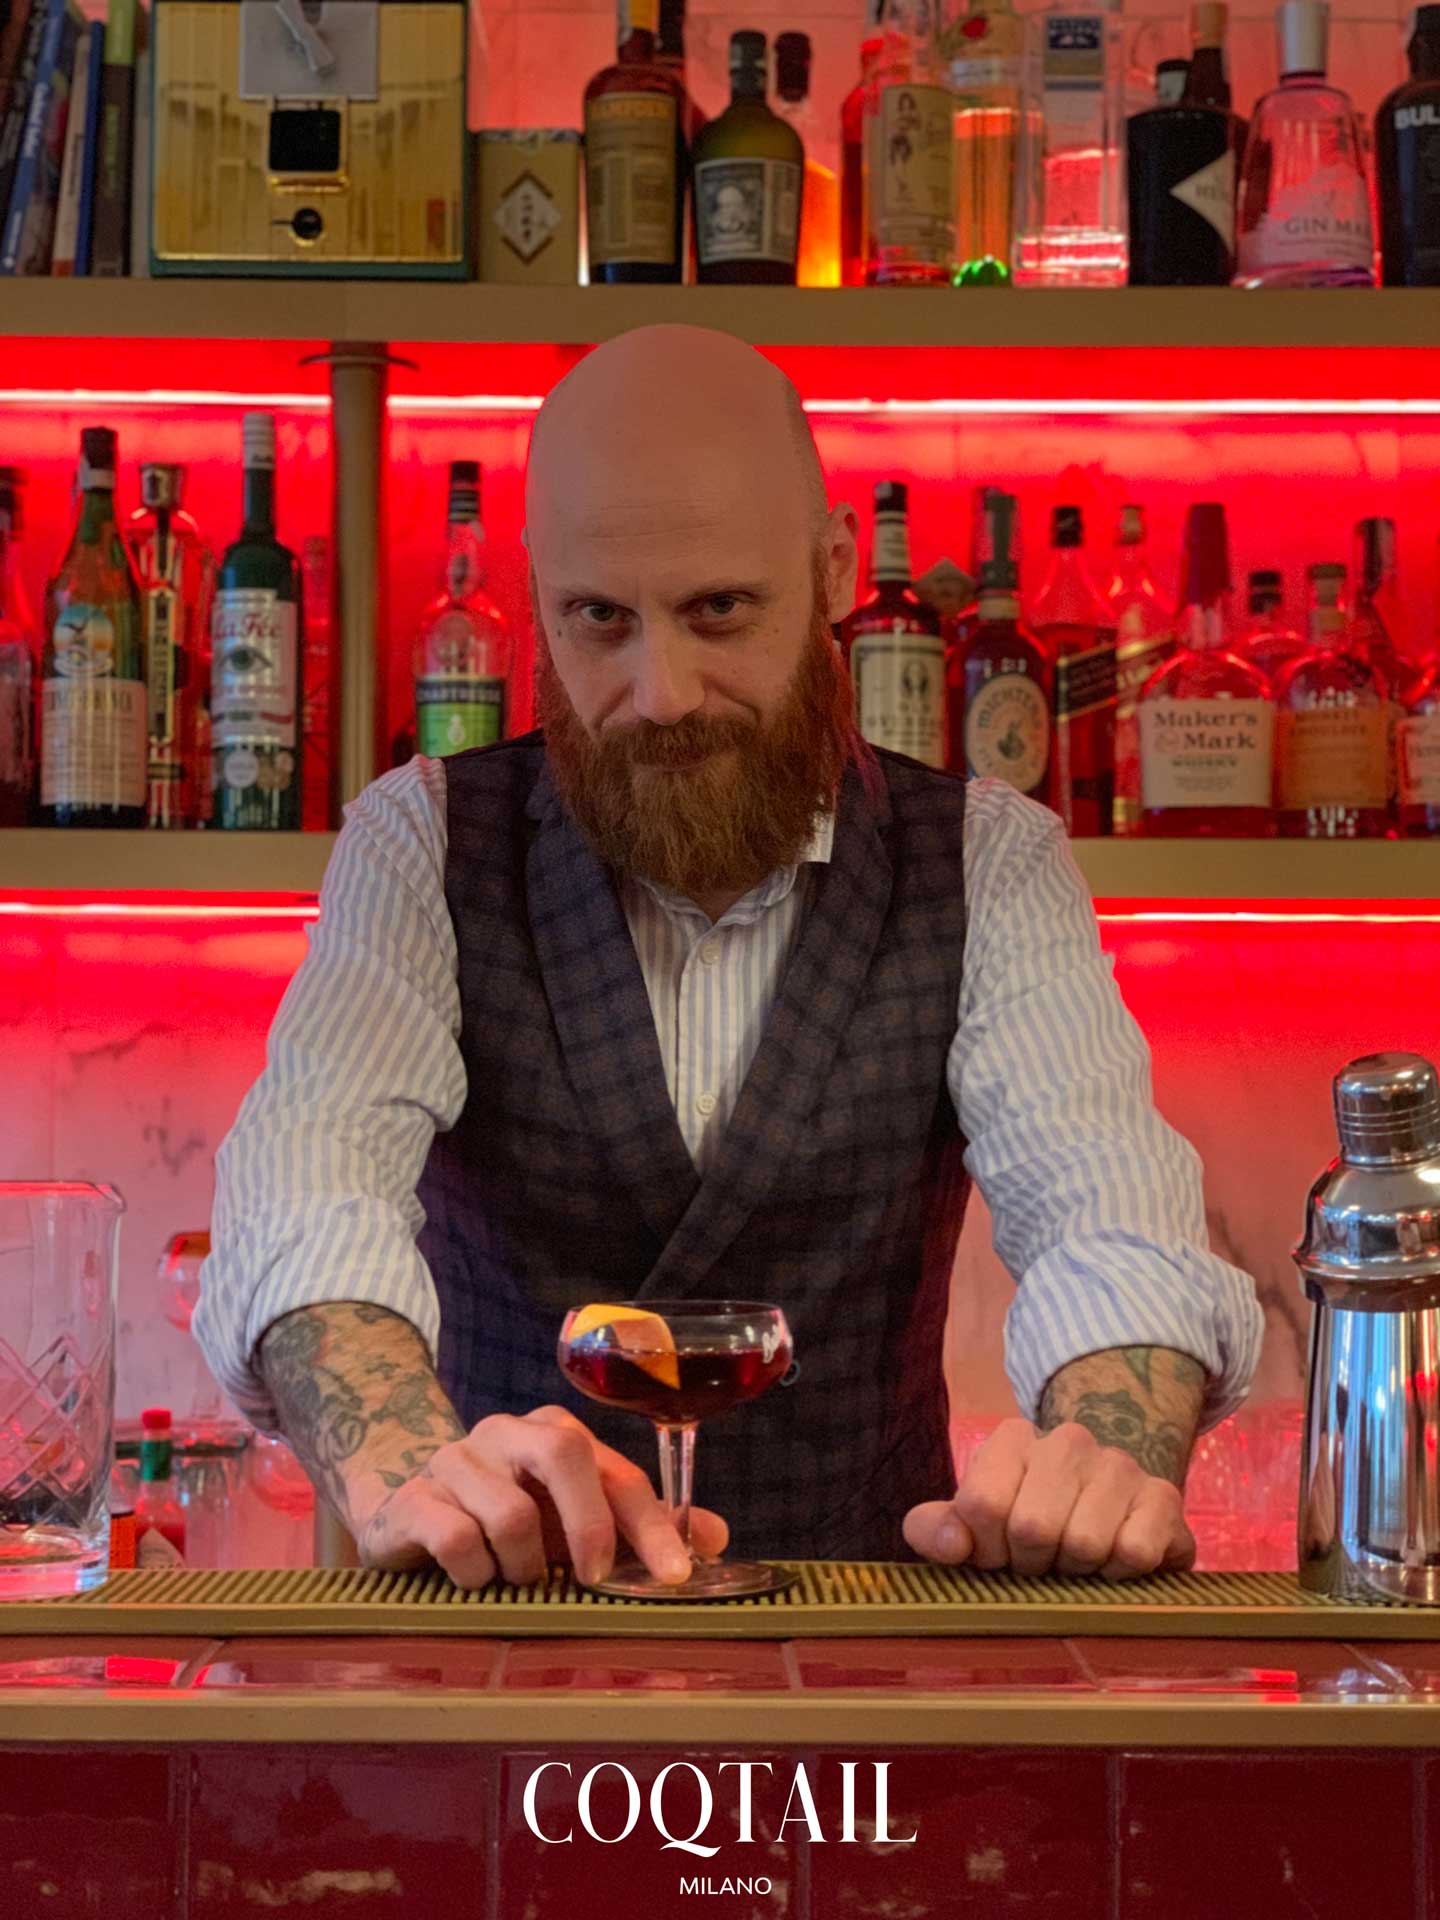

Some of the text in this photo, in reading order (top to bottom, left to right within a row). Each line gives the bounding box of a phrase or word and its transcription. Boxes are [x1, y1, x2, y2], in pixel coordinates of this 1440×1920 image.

[1284, 218, 1327, 234] GIN
[1153, 707, 1257, 728] Maker's
[1183, 731, 1256, 750] Mark
